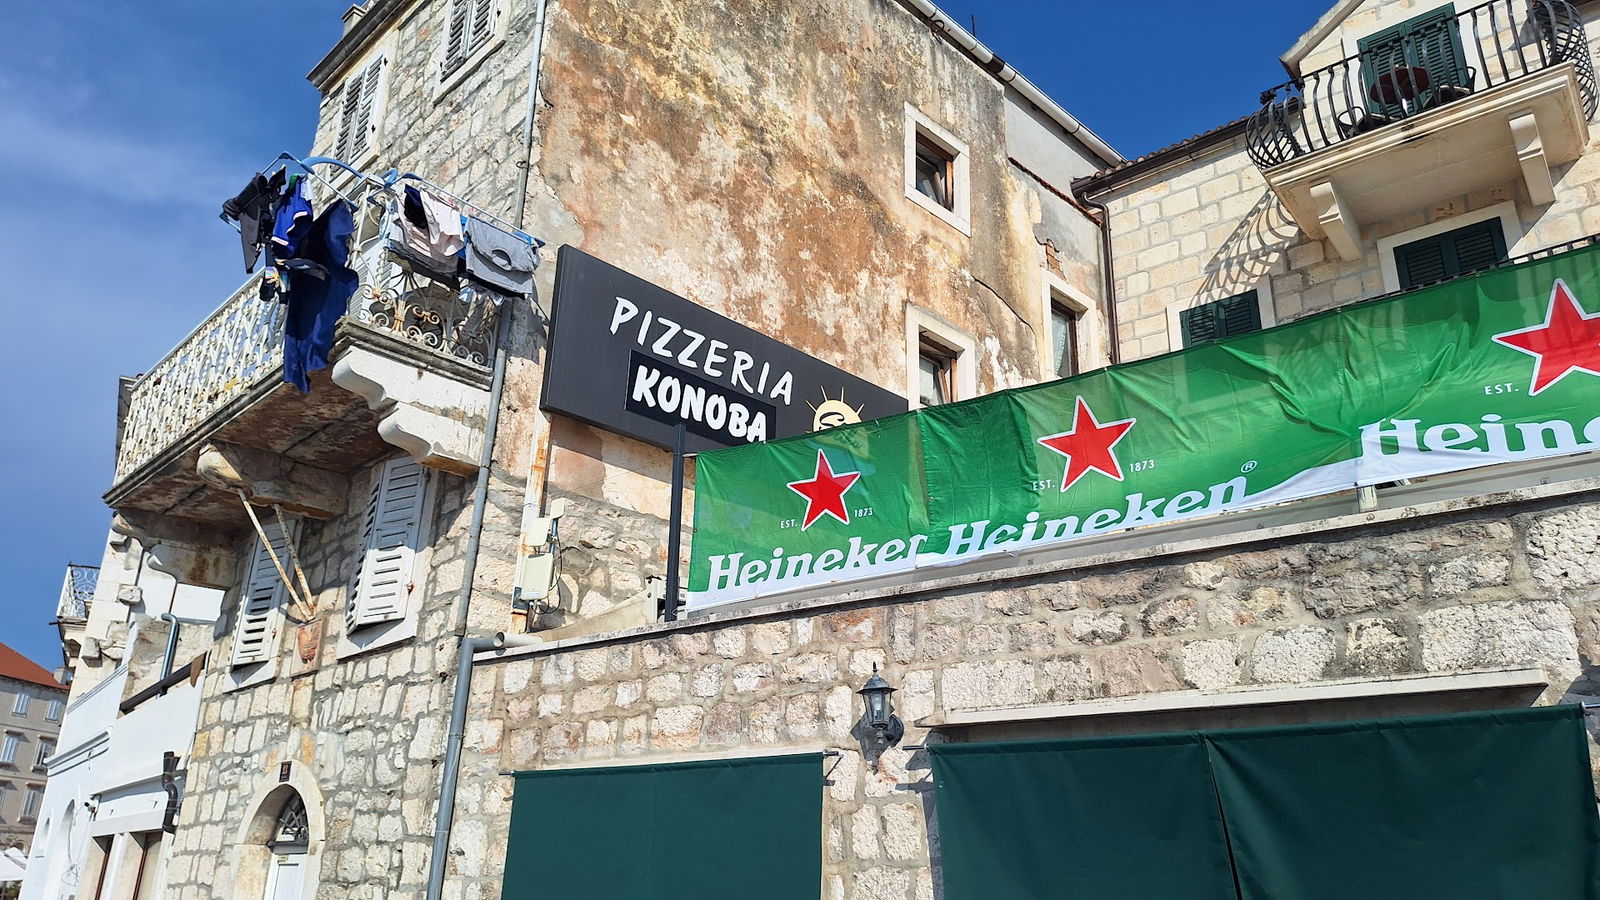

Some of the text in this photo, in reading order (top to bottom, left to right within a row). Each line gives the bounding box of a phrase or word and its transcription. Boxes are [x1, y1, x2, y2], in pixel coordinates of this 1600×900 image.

[609, 296, 794, 406] PIZZERIA
[632, 364, 767, 443] KONOBA
[1485, 382, 1519, 395] EST.
[1032, 459, 1155, 492] EST. 1873
[780, 507, 873, 529] EST. 1873
[944, 475, 1247, 555] Heineken
